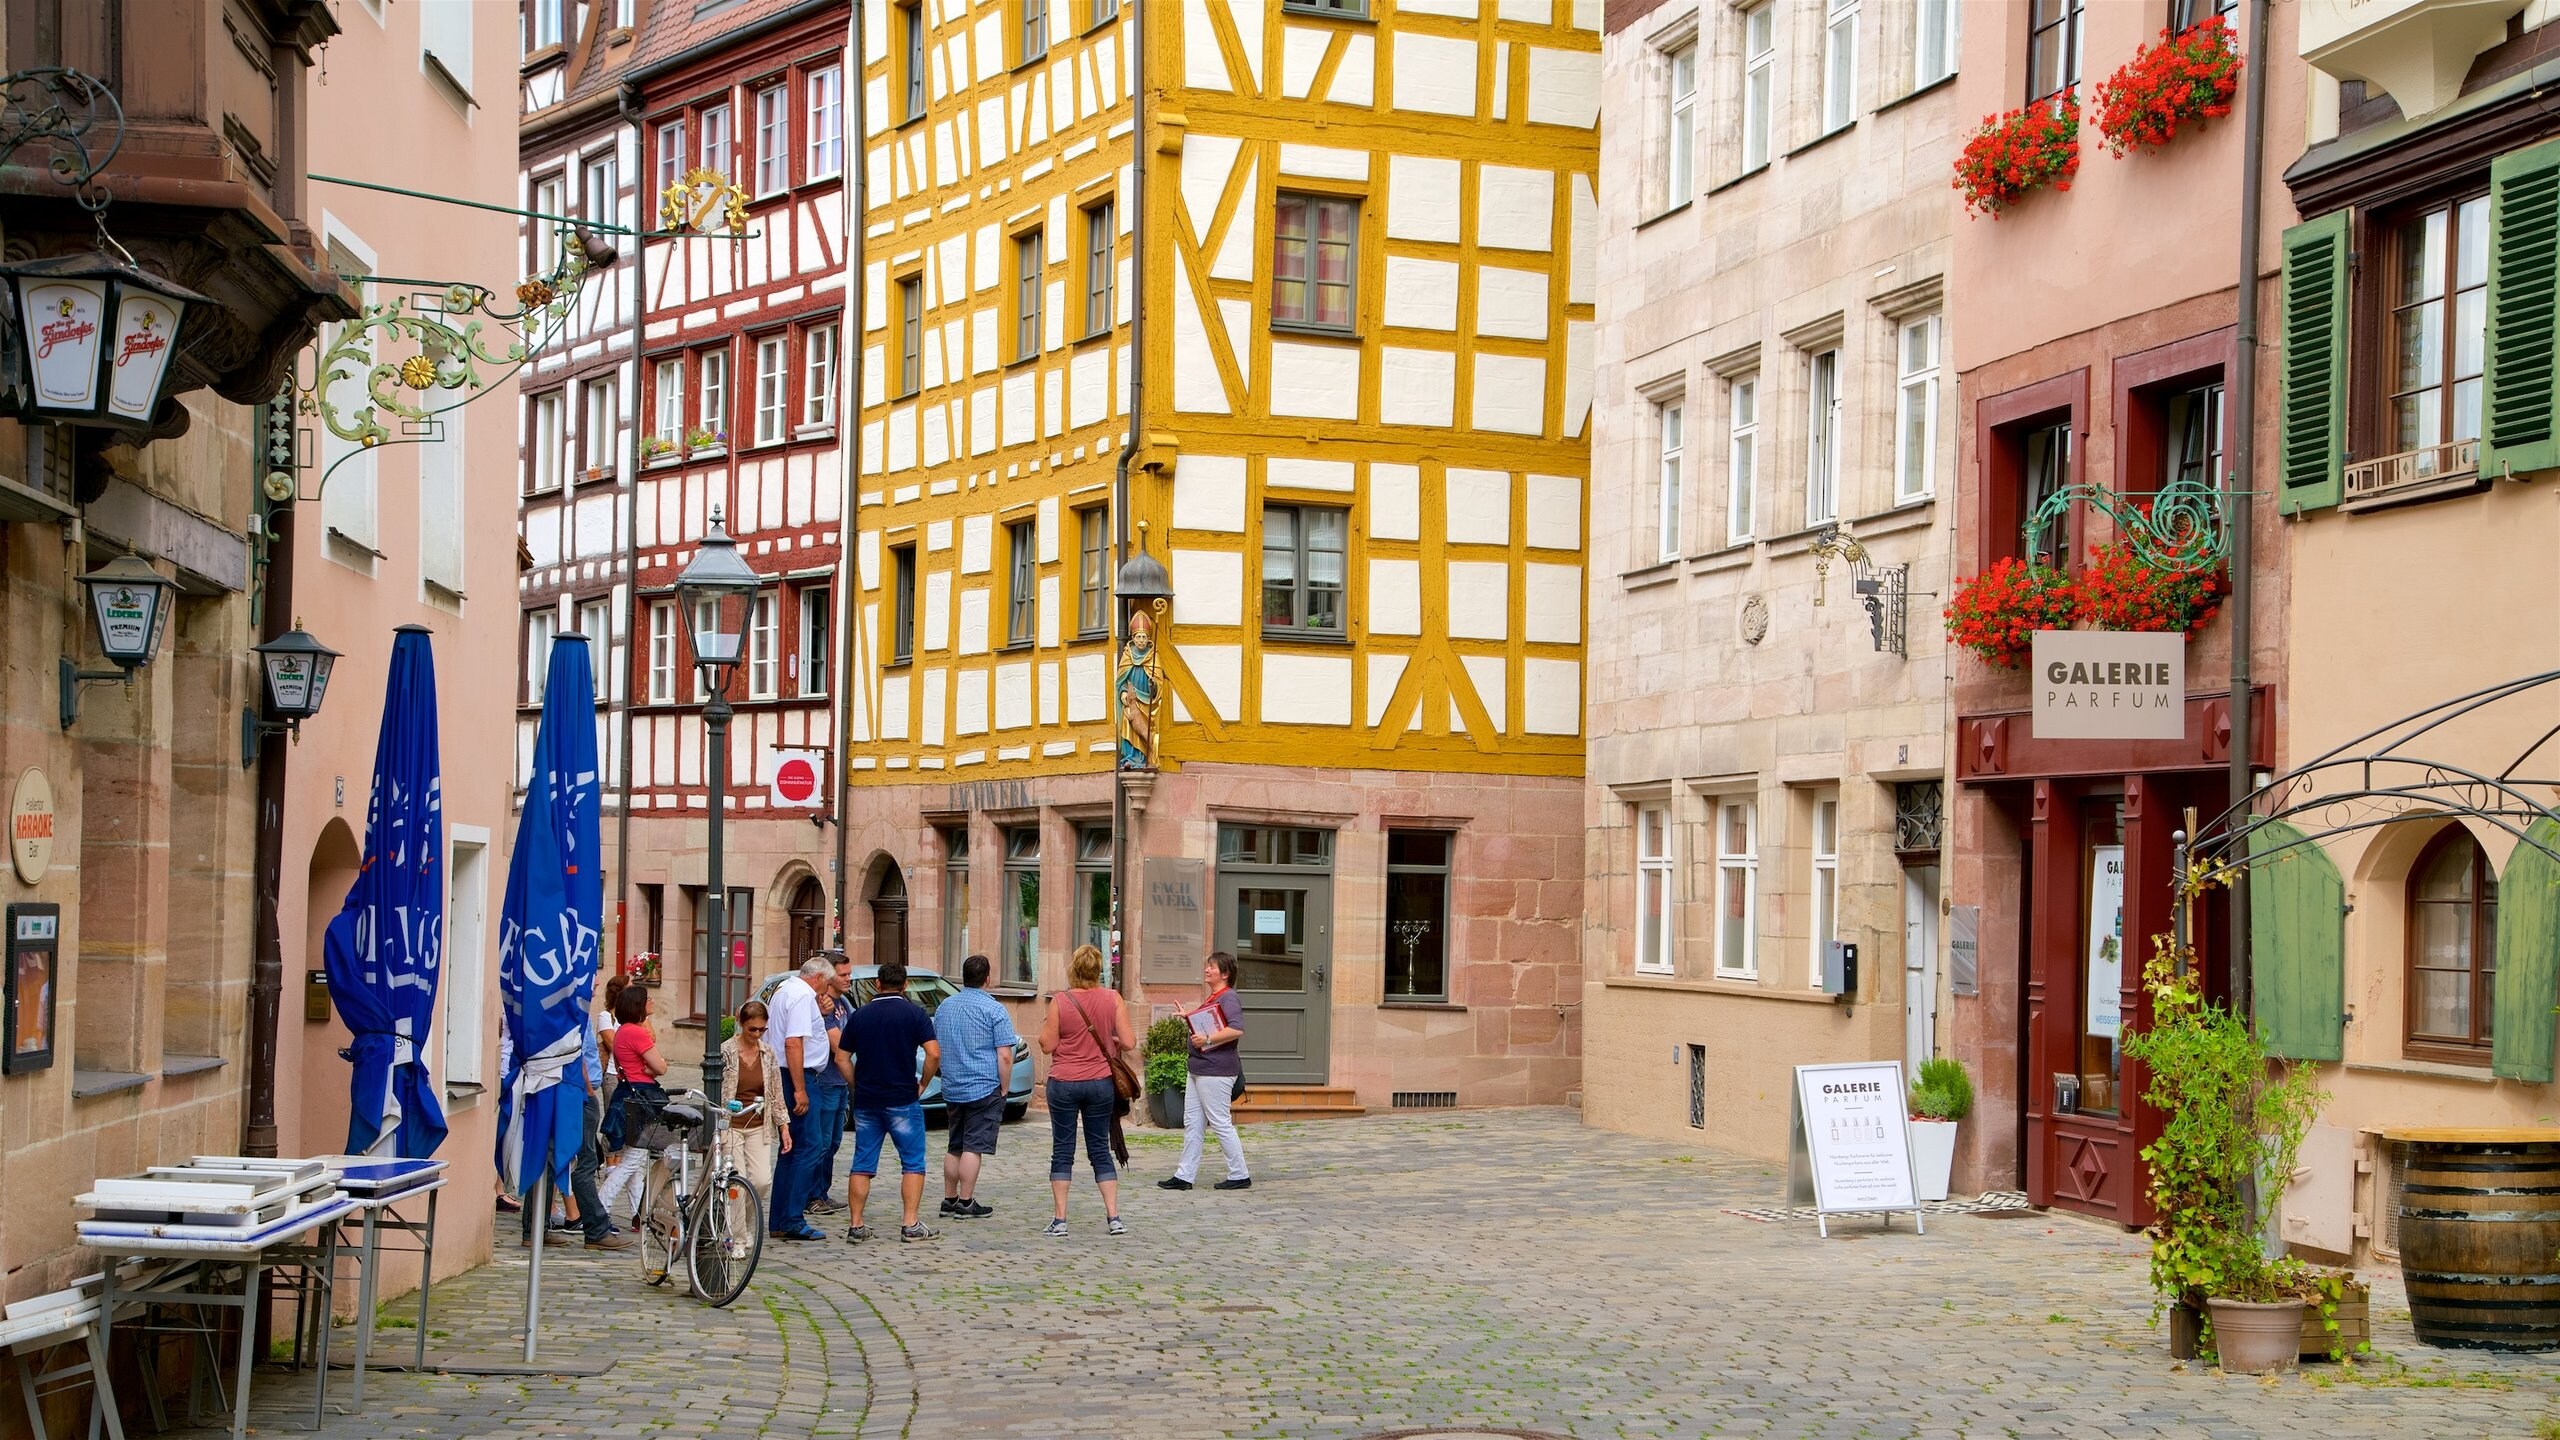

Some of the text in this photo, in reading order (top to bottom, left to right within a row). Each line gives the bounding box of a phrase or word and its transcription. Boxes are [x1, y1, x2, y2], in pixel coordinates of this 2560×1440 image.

[110, 624, 140, 632] PREMIUM
[2047, 661, 2170, 685] GALERIE
[2048, 691, 2169, 708] PARFUM
[16, 813, 53, 839] KARAOKE
[29, 840, 39, 857] Bar
[1952, 940, 1975, 950] GALERIE
[1823, 1082, 1881, 1094] GALERIE
[1824, 1095, 1882, 1103] PARFUM
